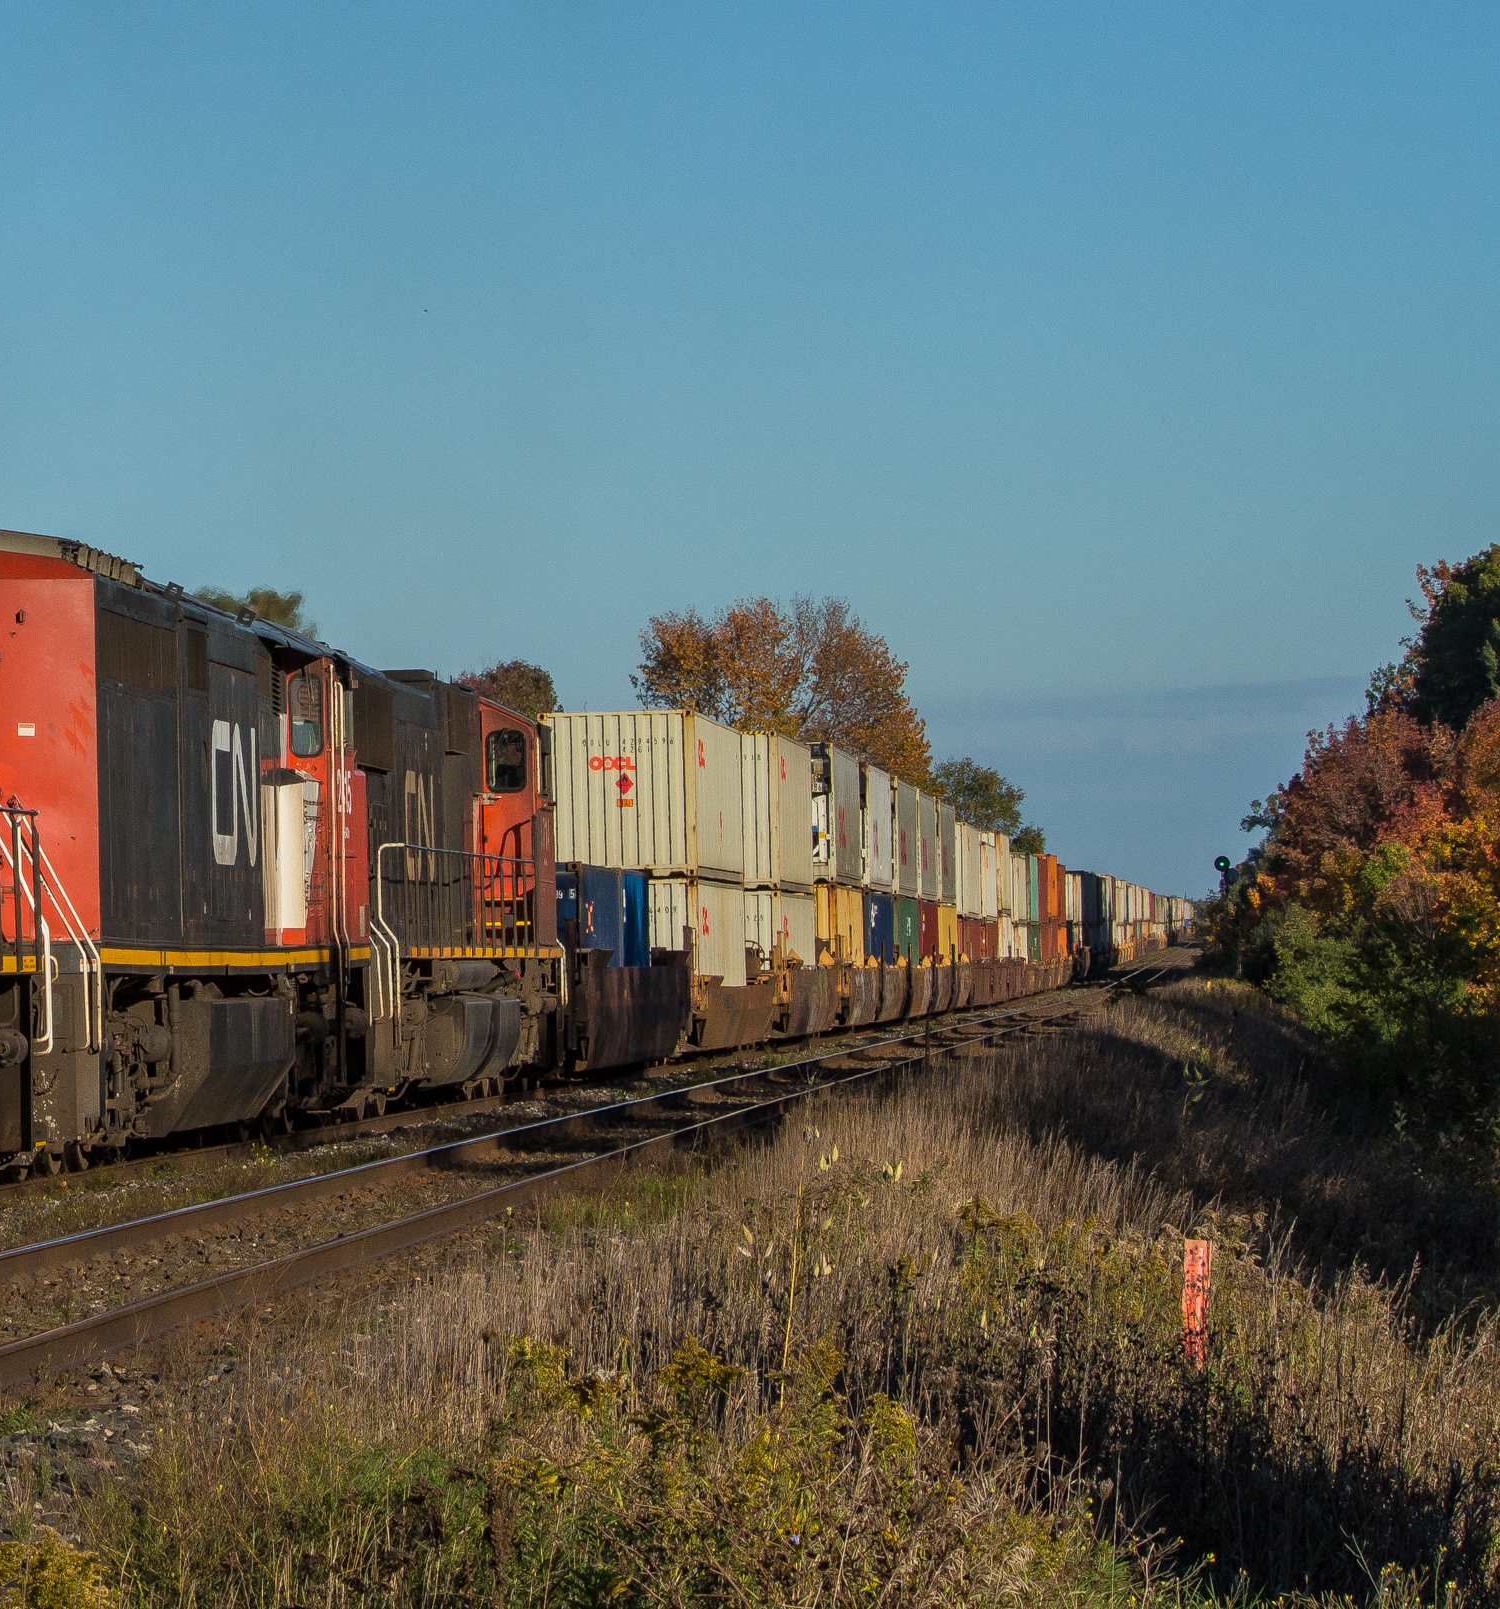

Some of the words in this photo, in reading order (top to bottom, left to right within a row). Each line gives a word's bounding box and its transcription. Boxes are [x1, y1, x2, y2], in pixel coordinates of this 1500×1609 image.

[211, 719, 258, 868] CN
[588, 755, 637, 771] OOCL
[405, 769, 436, 882] CN
